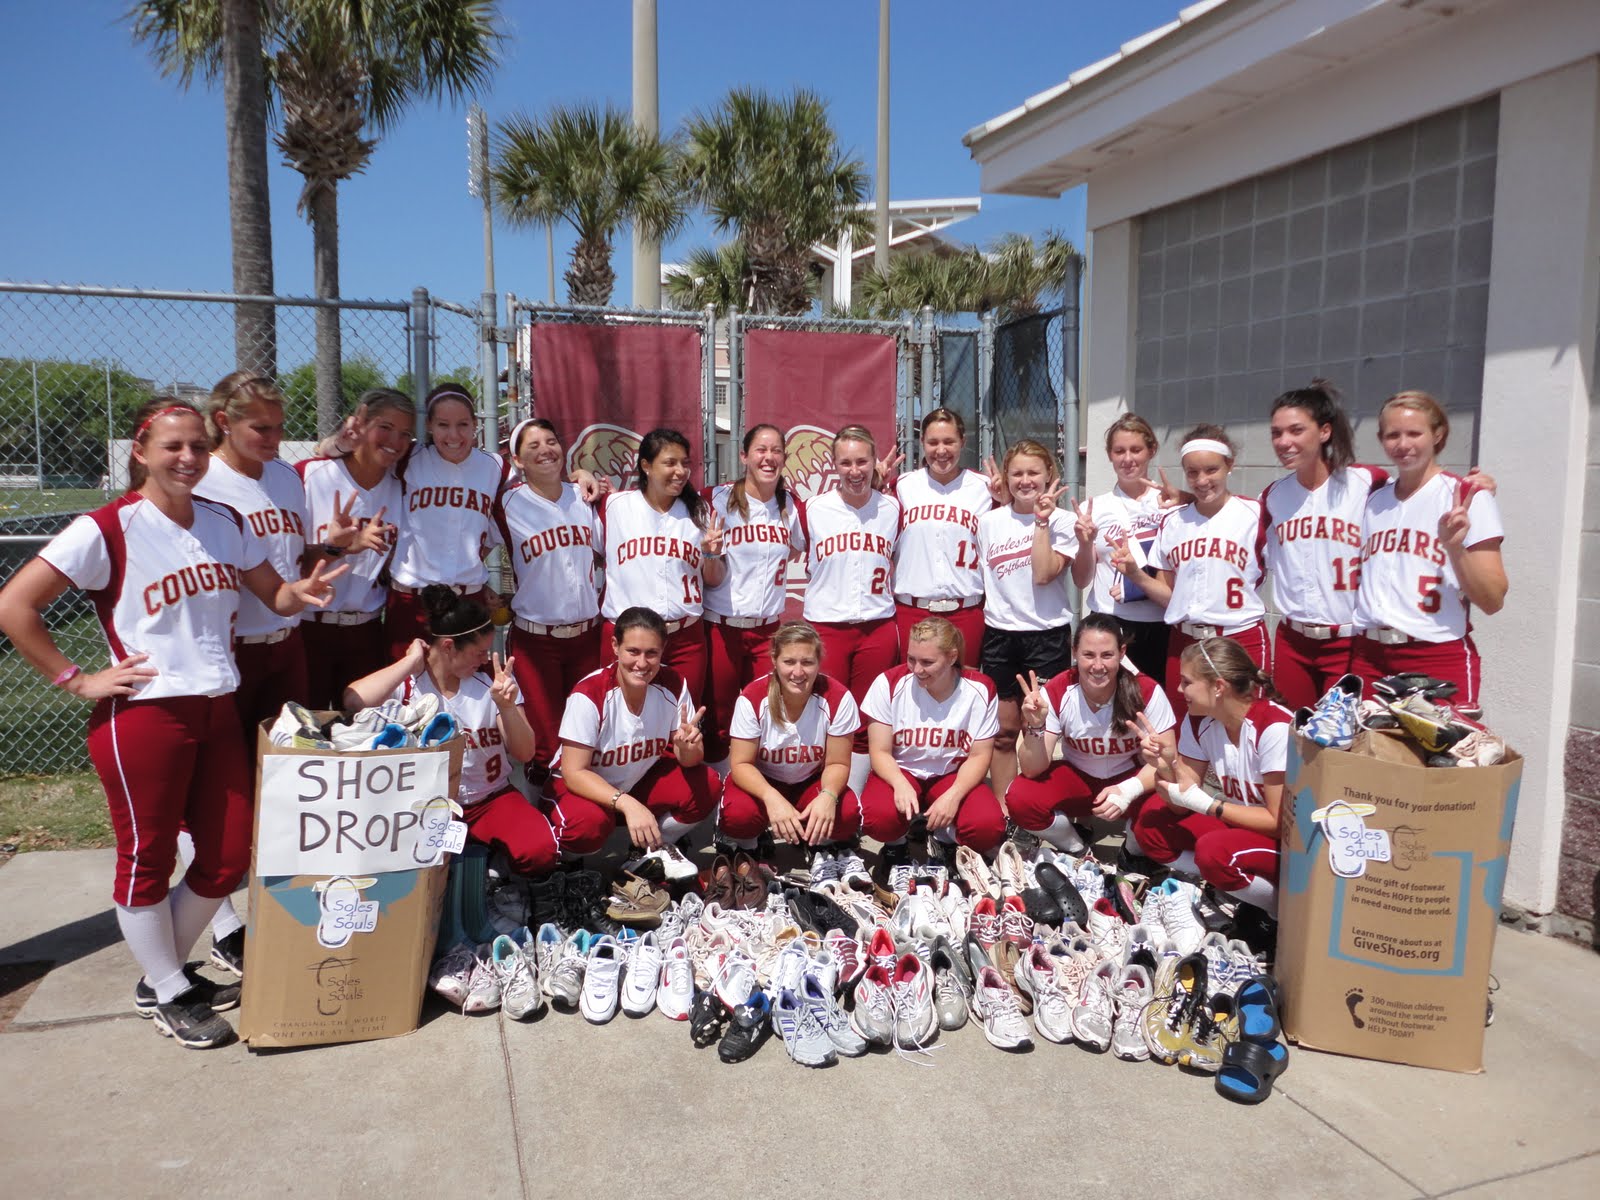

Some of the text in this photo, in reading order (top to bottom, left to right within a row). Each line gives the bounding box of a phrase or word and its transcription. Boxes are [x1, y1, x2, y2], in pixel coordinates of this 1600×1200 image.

[409, 486, 495, 519] COUGAR
[520, 524, 593, 565] COUGAR
[722, 523, 793, 548] COUGAR
[1275, 515, 1362, 549] OUGARS
[617, 536, 701, 570] COUGARS
[815, 532, 892, 563] COUGARS
[1361, 528, 1447, 567] OUGARS
[1332, 556, 1362, 592] 12
[143, 562, 243, 617] COUGAR
[682, 574, 702, 604] 13
[1226, 577, 1245, 609] 6
[1417, 575, 1443, 614] 5
[590, 737, 667, 768] COUGAR
[893, 727, 974, 754] COUGARS
[760, 745, 824, 765] OUGAR
[298, 759, 416, 803] SHOE
[485, 753, 502, 784] 9
[1343, 786, 1477, 813] Thank you for your donation!
[299, 810, 418, 854] DROP
[428, 816, 463, 833] Soles
[1338, 823, 1383, 841] Soles
[426, 834, 463, 851] Souls
[1344, 842, 1389, 860] Souls
[1355, 884, 1451, 905] provides HOPE to people
[1364, 873, 1446, 892] Your gift of footwear
[333, 897, 373, 913] Soles
[1351, 894, 1452, 916] in need around the world.
[333, 913, 374, 930] Souls
[1351, 926, 1375, 939] Learn
[1376, 932, 1398, 944] more
[1398, 939, 1423, 947] about
[1353, 936, 1440, 962] GiveShoes.org
[327, 973, 361, 988] Soles
[328, 986, 364, 1002] Souls
[1386, 1001, 1413, 1010] million
[1414, 1003, 1445, 1012] children
[1368, 1016, 1399, 1028] without
[1369, 1006, 1397, 1018] around
[1398, 1011, 1412, 1019] the
[1412, 1013, 1434, 1021] world
[1367, 1024, 1415, 1038] HELP TODAY!
